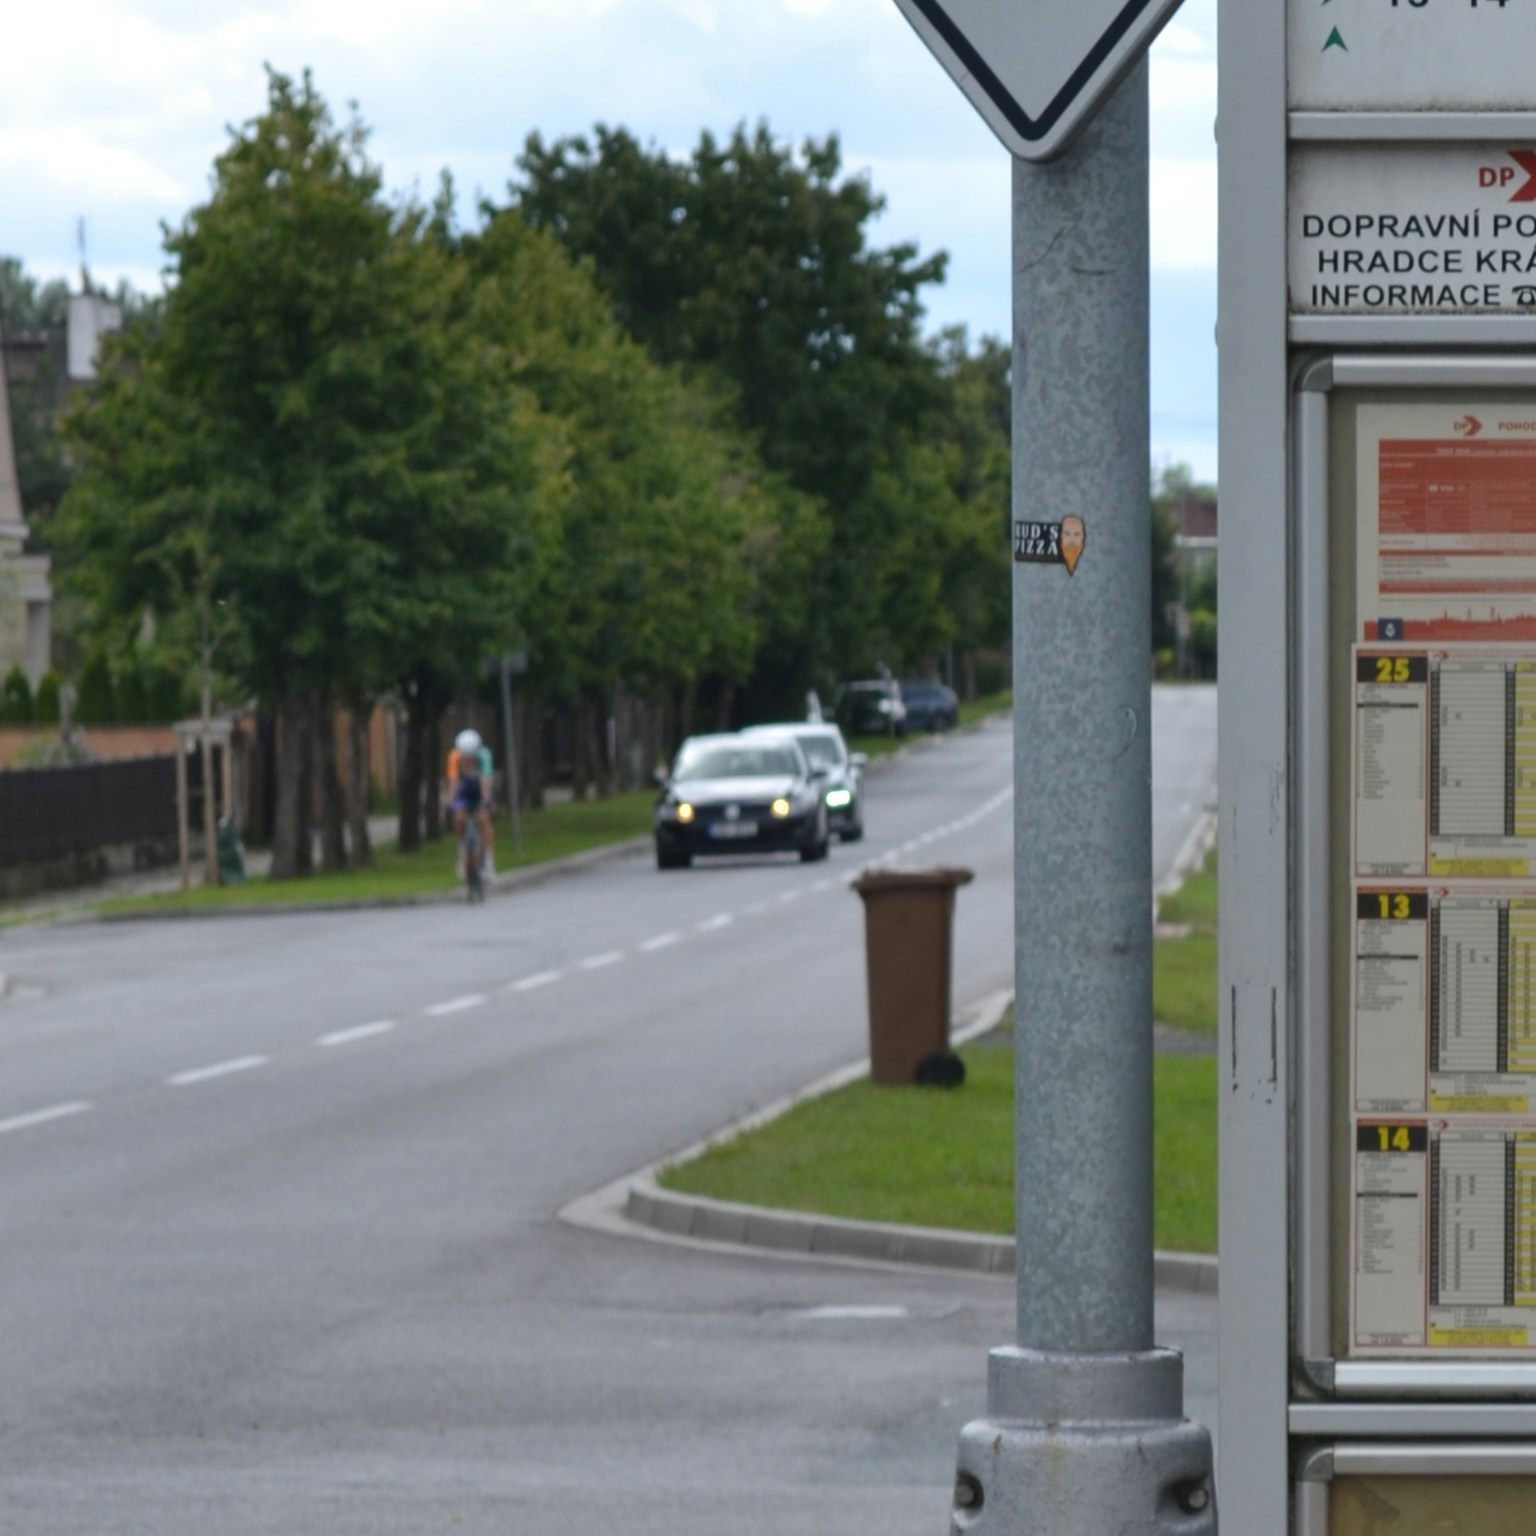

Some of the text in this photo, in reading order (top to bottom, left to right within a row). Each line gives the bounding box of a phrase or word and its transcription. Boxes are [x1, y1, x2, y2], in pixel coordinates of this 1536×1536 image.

[1478, 166, 1515, 189] DP
[1302, 210, 1481, 239] DOPRAVNÍ
[1317, 249, 1464, 274] HRADCE
[1310, 284, 1501, 307] INFORMACE
[1375, 656, 1411, 683] 25
[1377, 894, 1411, 919] 13
[1377, 1126, 1411, 1151] 14
